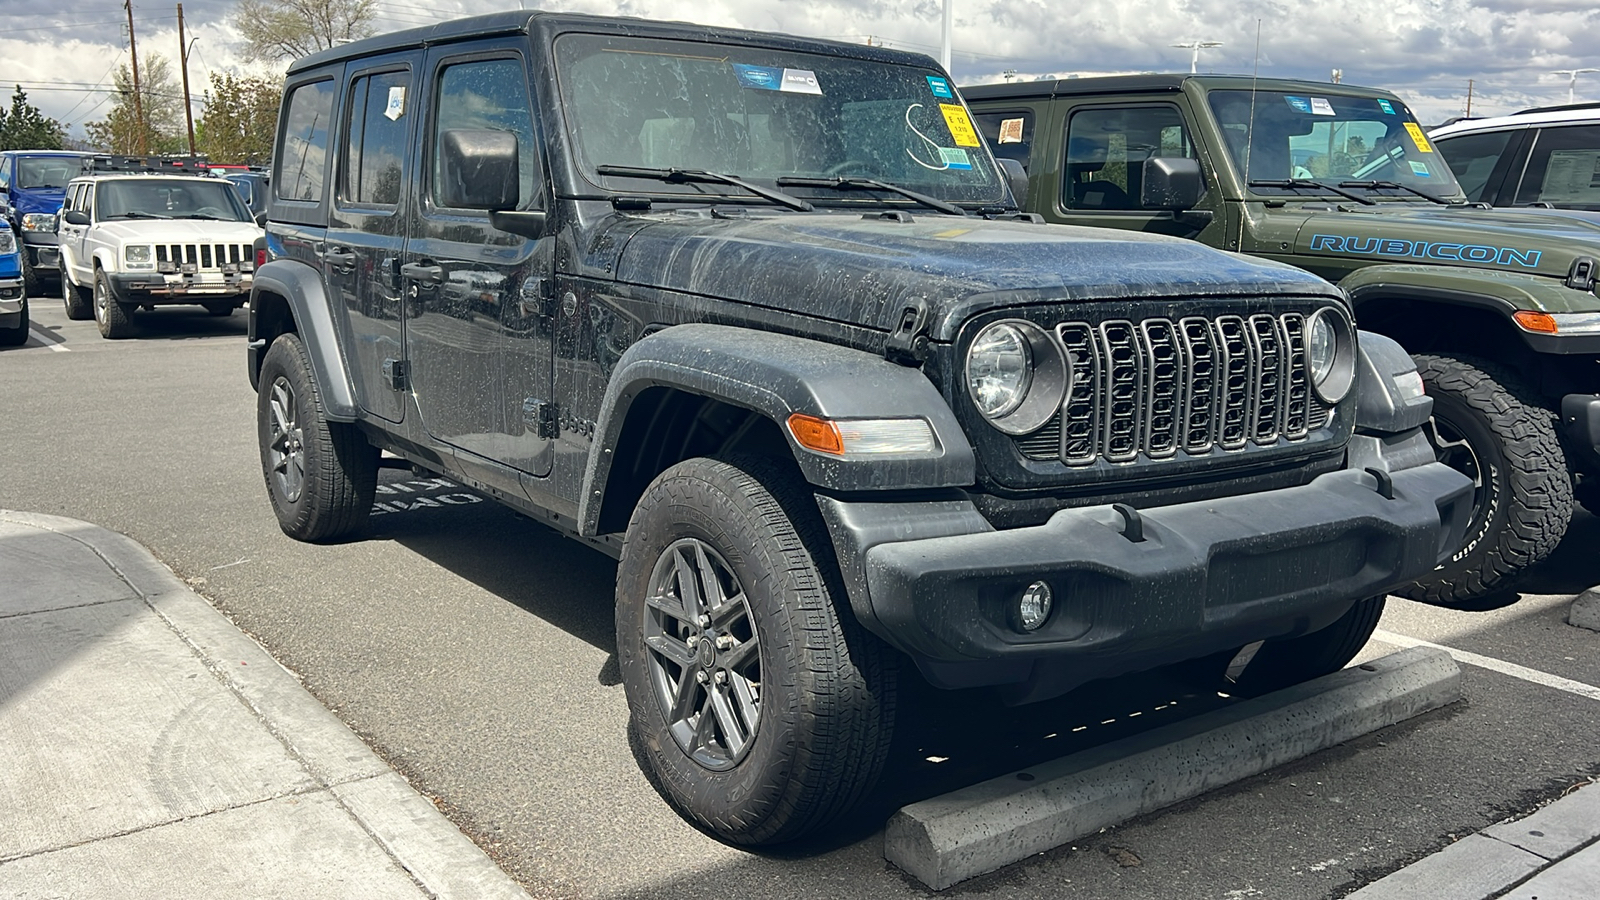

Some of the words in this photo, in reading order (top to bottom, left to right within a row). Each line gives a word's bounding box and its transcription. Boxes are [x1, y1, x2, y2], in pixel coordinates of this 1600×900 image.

[906, 103, 950, 170] S
[1310, 234, 1542, 267] RUBICON
[1452, 463, 1500, 562] All-Terrain
